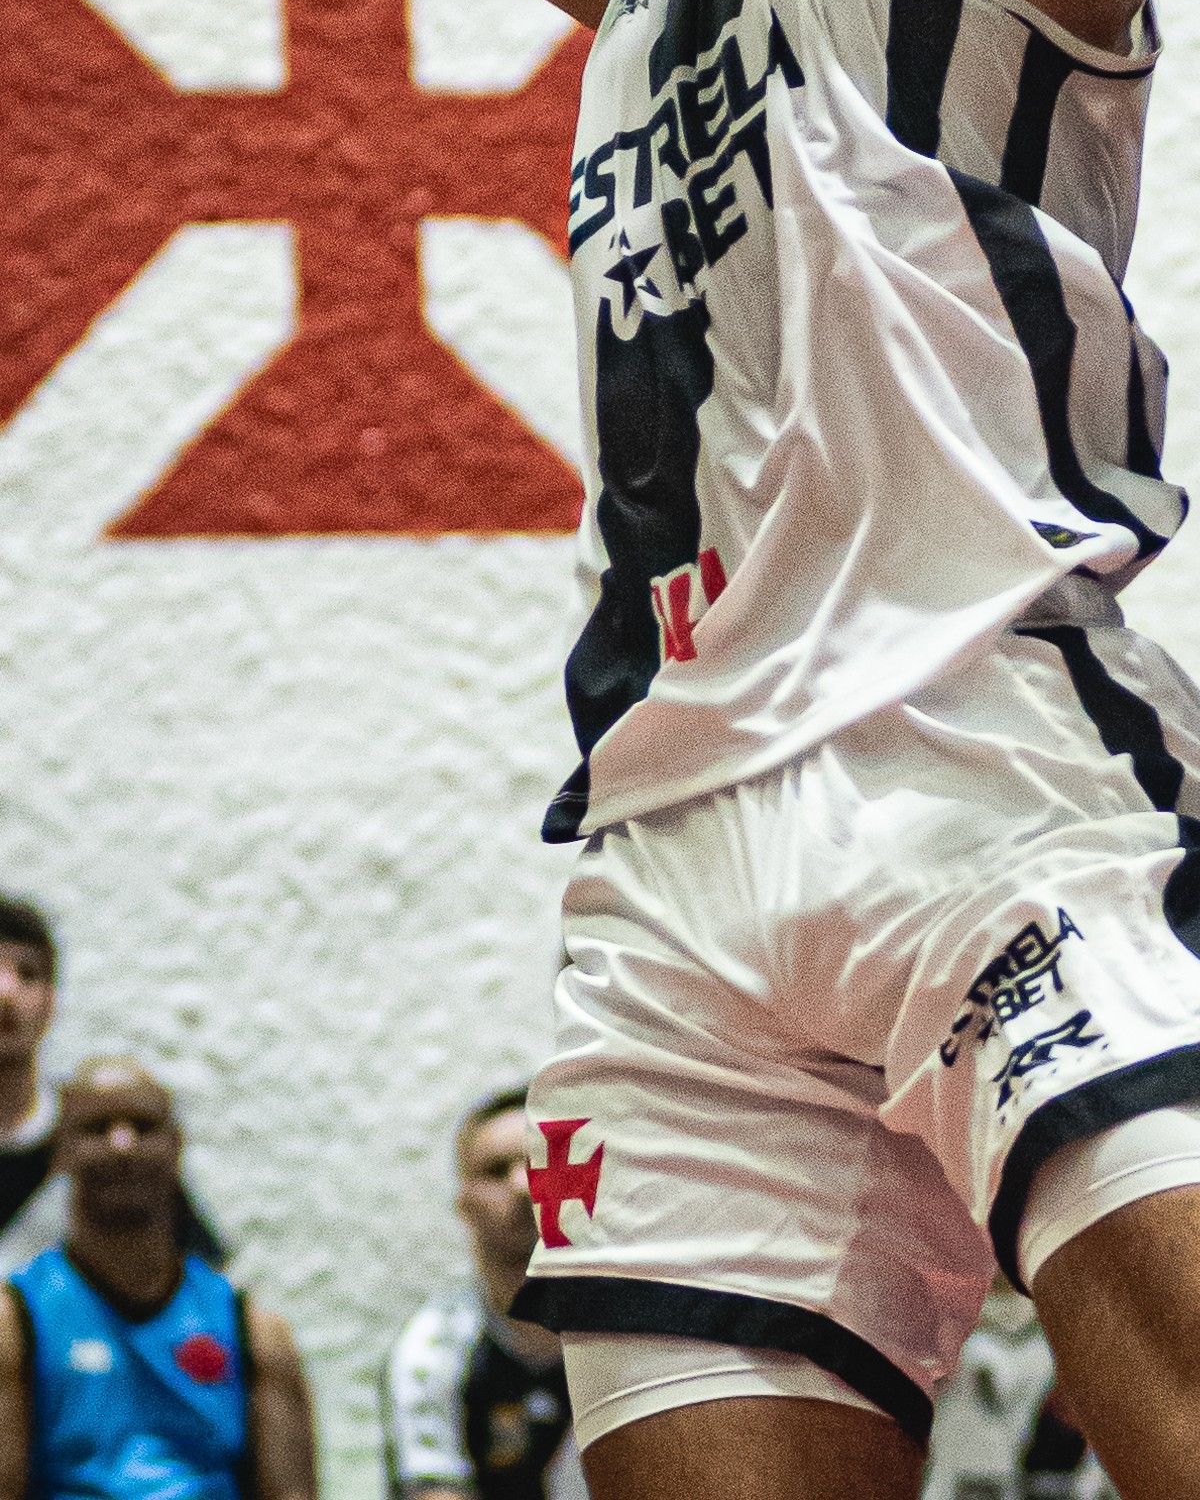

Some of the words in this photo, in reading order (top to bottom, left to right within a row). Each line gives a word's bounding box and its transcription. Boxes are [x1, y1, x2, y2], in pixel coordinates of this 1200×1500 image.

[568, 5, 806, 258] ESTRELA
[660, 111, 775, 296] BET
[991, 950, 1064, 1024] BET
